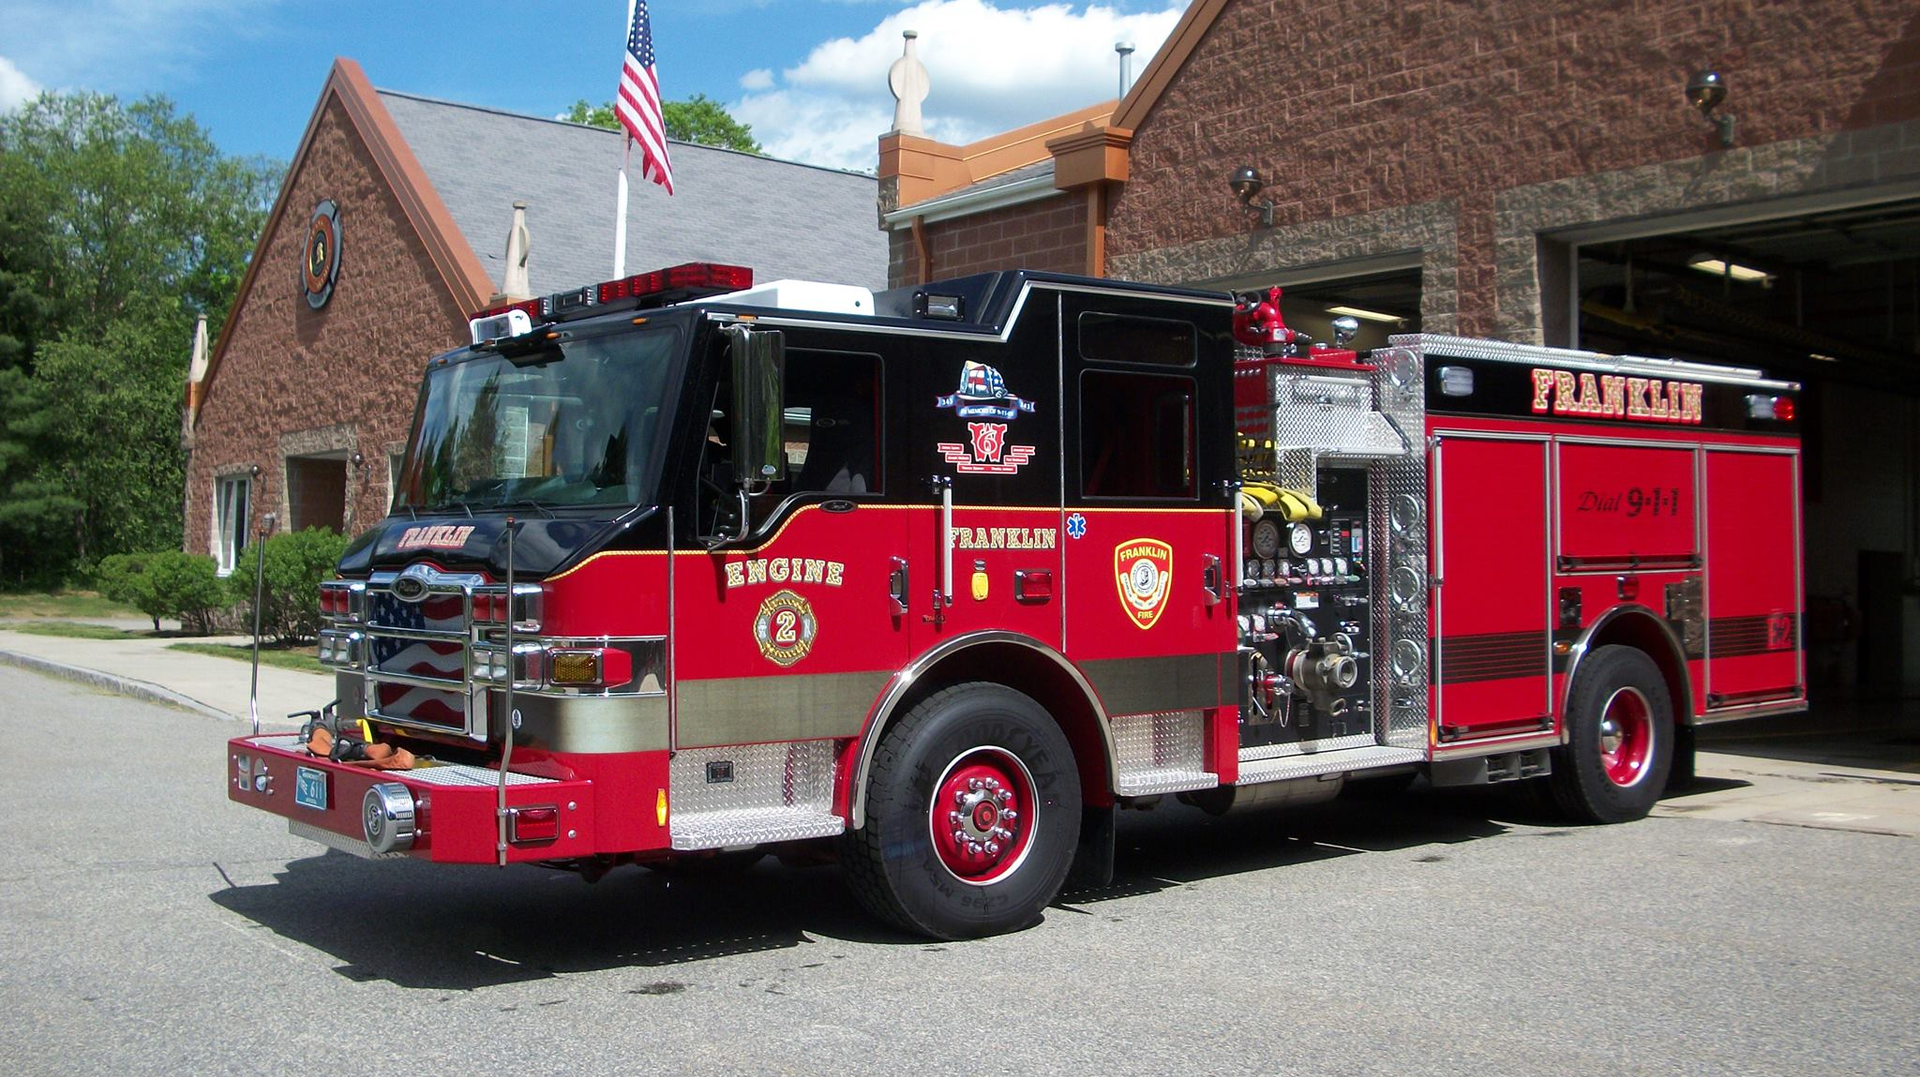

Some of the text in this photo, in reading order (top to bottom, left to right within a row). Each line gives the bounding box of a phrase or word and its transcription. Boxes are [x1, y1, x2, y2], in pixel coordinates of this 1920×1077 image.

[1532, 368, 1702, 424] FRANKLIN
[1577, 490, 1622, 512] Dial
[396, 525, 476, 551] FRANKLIN
[951, 528, 1056, 549] FRANKLIN
[1120, 546, 1167, 562] FRANKLIN
[725, 557, 844, 588] ENGINE
[776, 611, 796, 642] 2
[1137, 610, 1154, 619] FIRE
